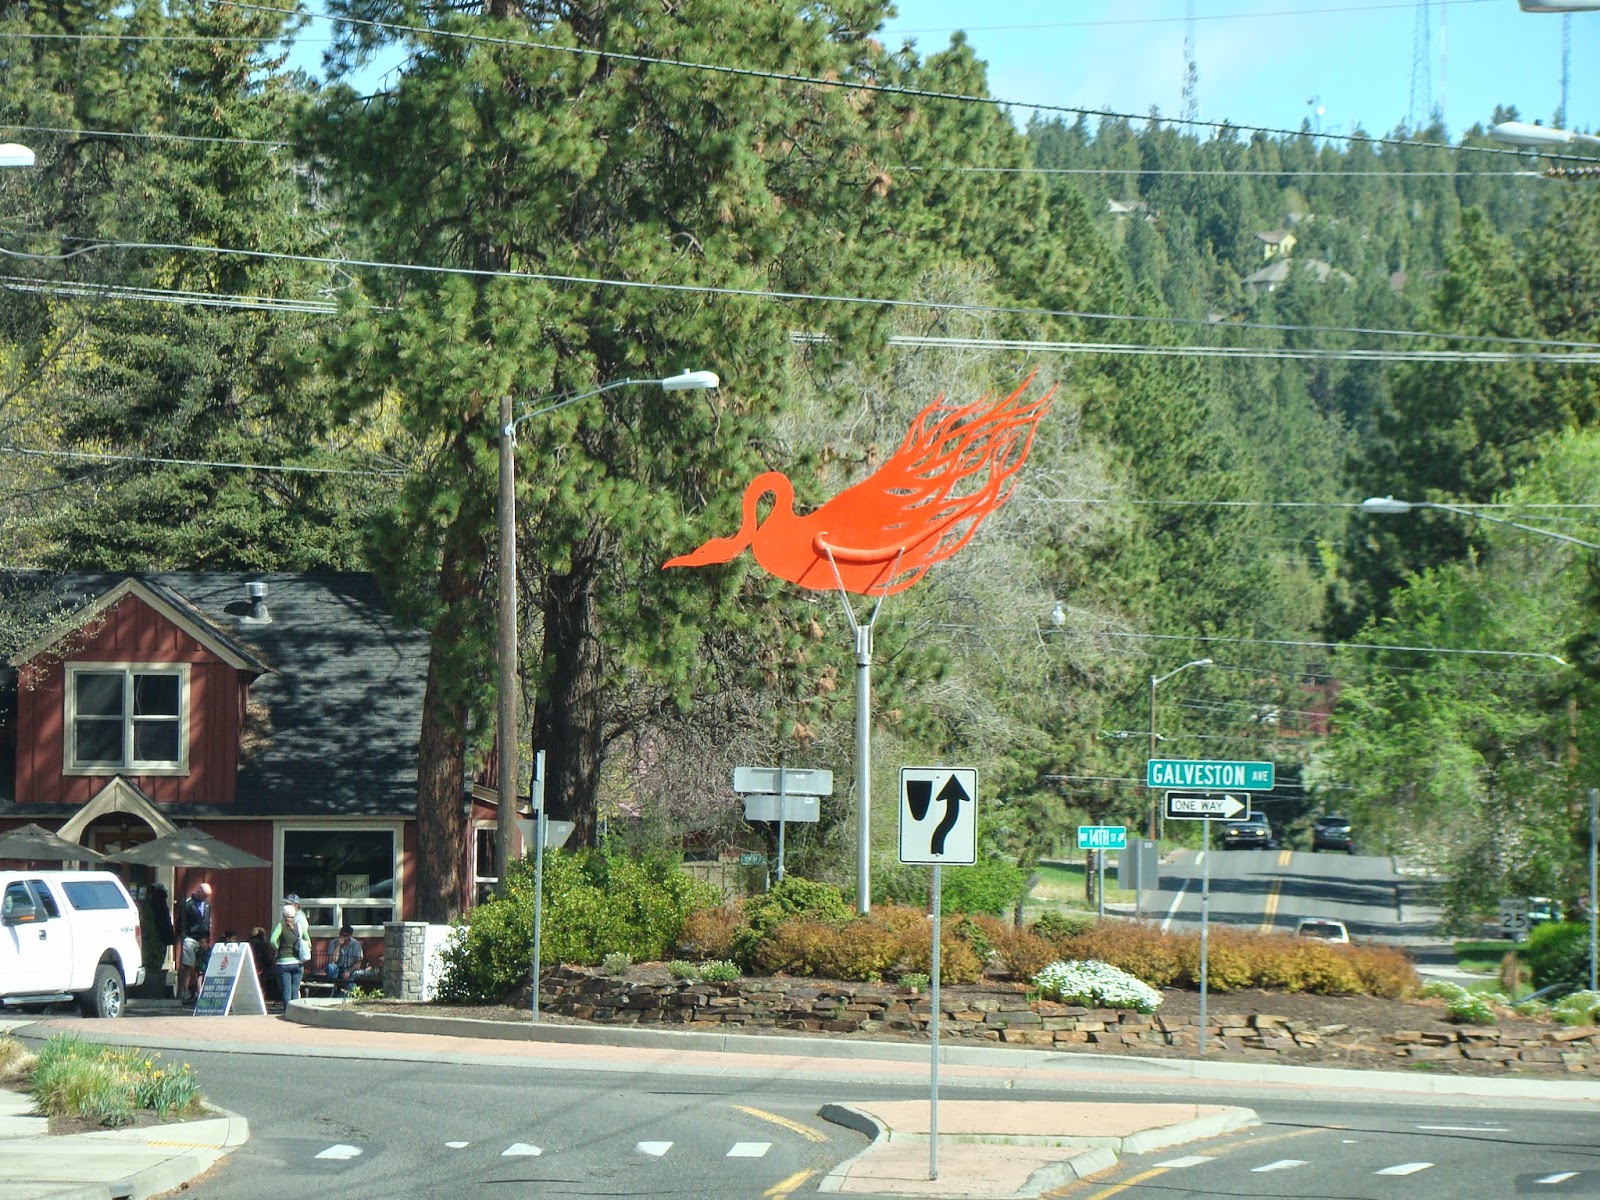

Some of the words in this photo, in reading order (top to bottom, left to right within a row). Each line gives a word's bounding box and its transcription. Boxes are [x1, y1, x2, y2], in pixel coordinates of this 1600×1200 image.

[1152, 763, 1246, 786] GALVESTON
[1251, 771, 1270, 782] AVE
[1174, 800, 1196, 811] ONE
[1201, 801, 1225, 811] WAY
[1089, 829, 1110, 846] 14TH
[340, 880, 368, 895] Open
[1503, 913, 1527, 928] 25
